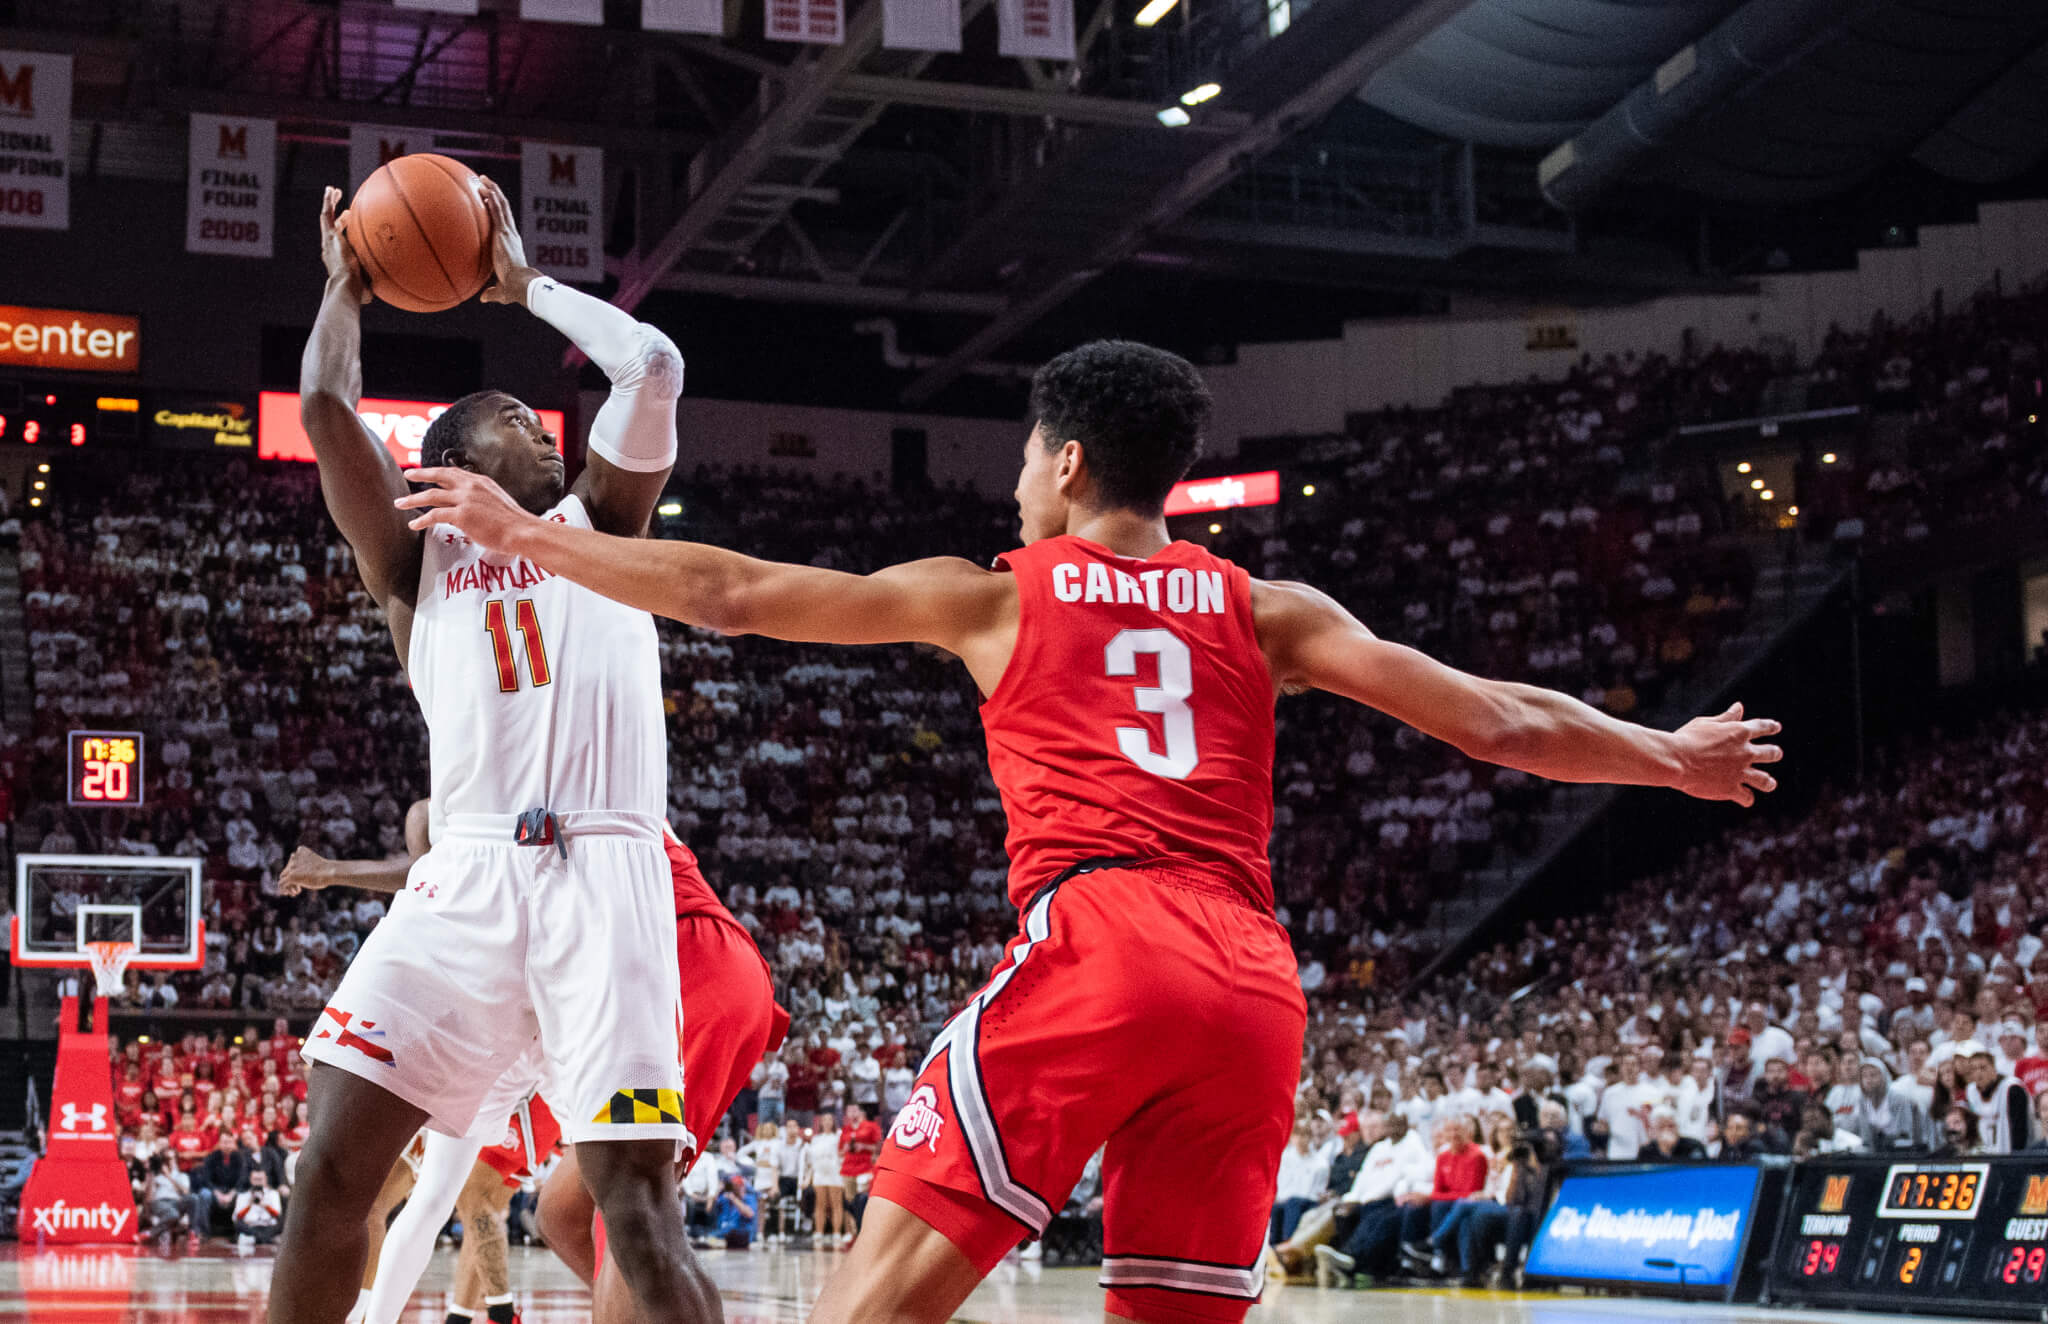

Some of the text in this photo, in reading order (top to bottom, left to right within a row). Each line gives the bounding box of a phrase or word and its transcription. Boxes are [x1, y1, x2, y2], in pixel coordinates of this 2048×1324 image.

[201, 168, 261, 190] FINAL
[203, 189, 258, 209] FOUR
[532, 196, 592, 217] FINAL
[536, 217, 589, 235] FOUR
[1052, 562, 1226, 615] CARTON
[485, 598, 551, 693] 11
[1104, 627, 1199, 781] 3
[82, 737, 137, 764] 17:36
[82, 760, 129, 800] 20
[1898, 1173, 1977, 1210] 17:36
[33, 1200, 130, 1237] xfinity
[1550, 1203, 1740, 1249] The Washington Post
[1801, 1214, 1851, 1236] TERRAPINS
[1898, 1223, 1941, 1243] PERIOD
[1803, 1240, 1840, 1275] 34
[1900, 1247, 1922, 1284] 2
[2003, 1246, 2046, 1284] 29
